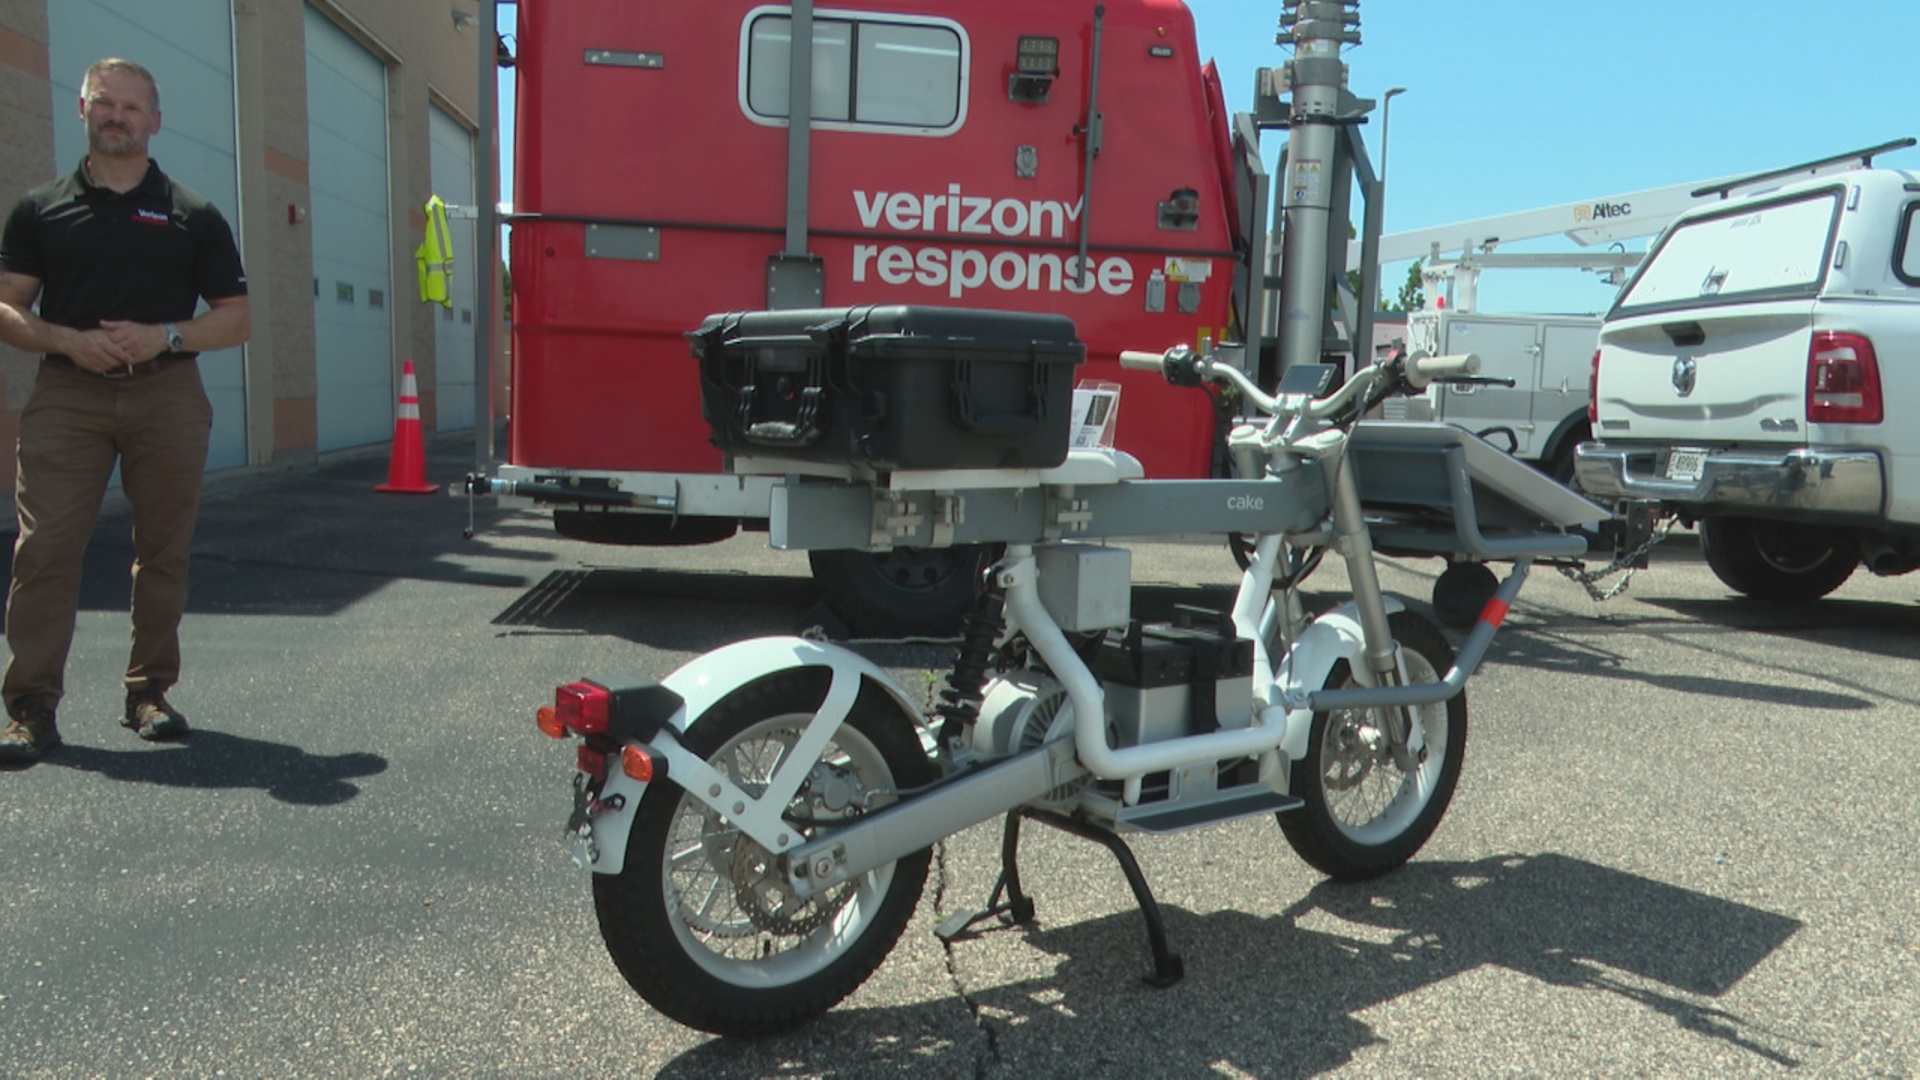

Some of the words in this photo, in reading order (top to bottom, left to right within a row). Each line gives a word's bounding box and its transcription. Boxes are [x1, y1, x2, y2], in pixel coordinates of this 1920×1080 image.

[853, 183, 1064, 238] verizon
[1592, 202, 1631, 220] Altec
[852, 244, 1134, 298] response
[1227, 494, 1264, 511] cake
